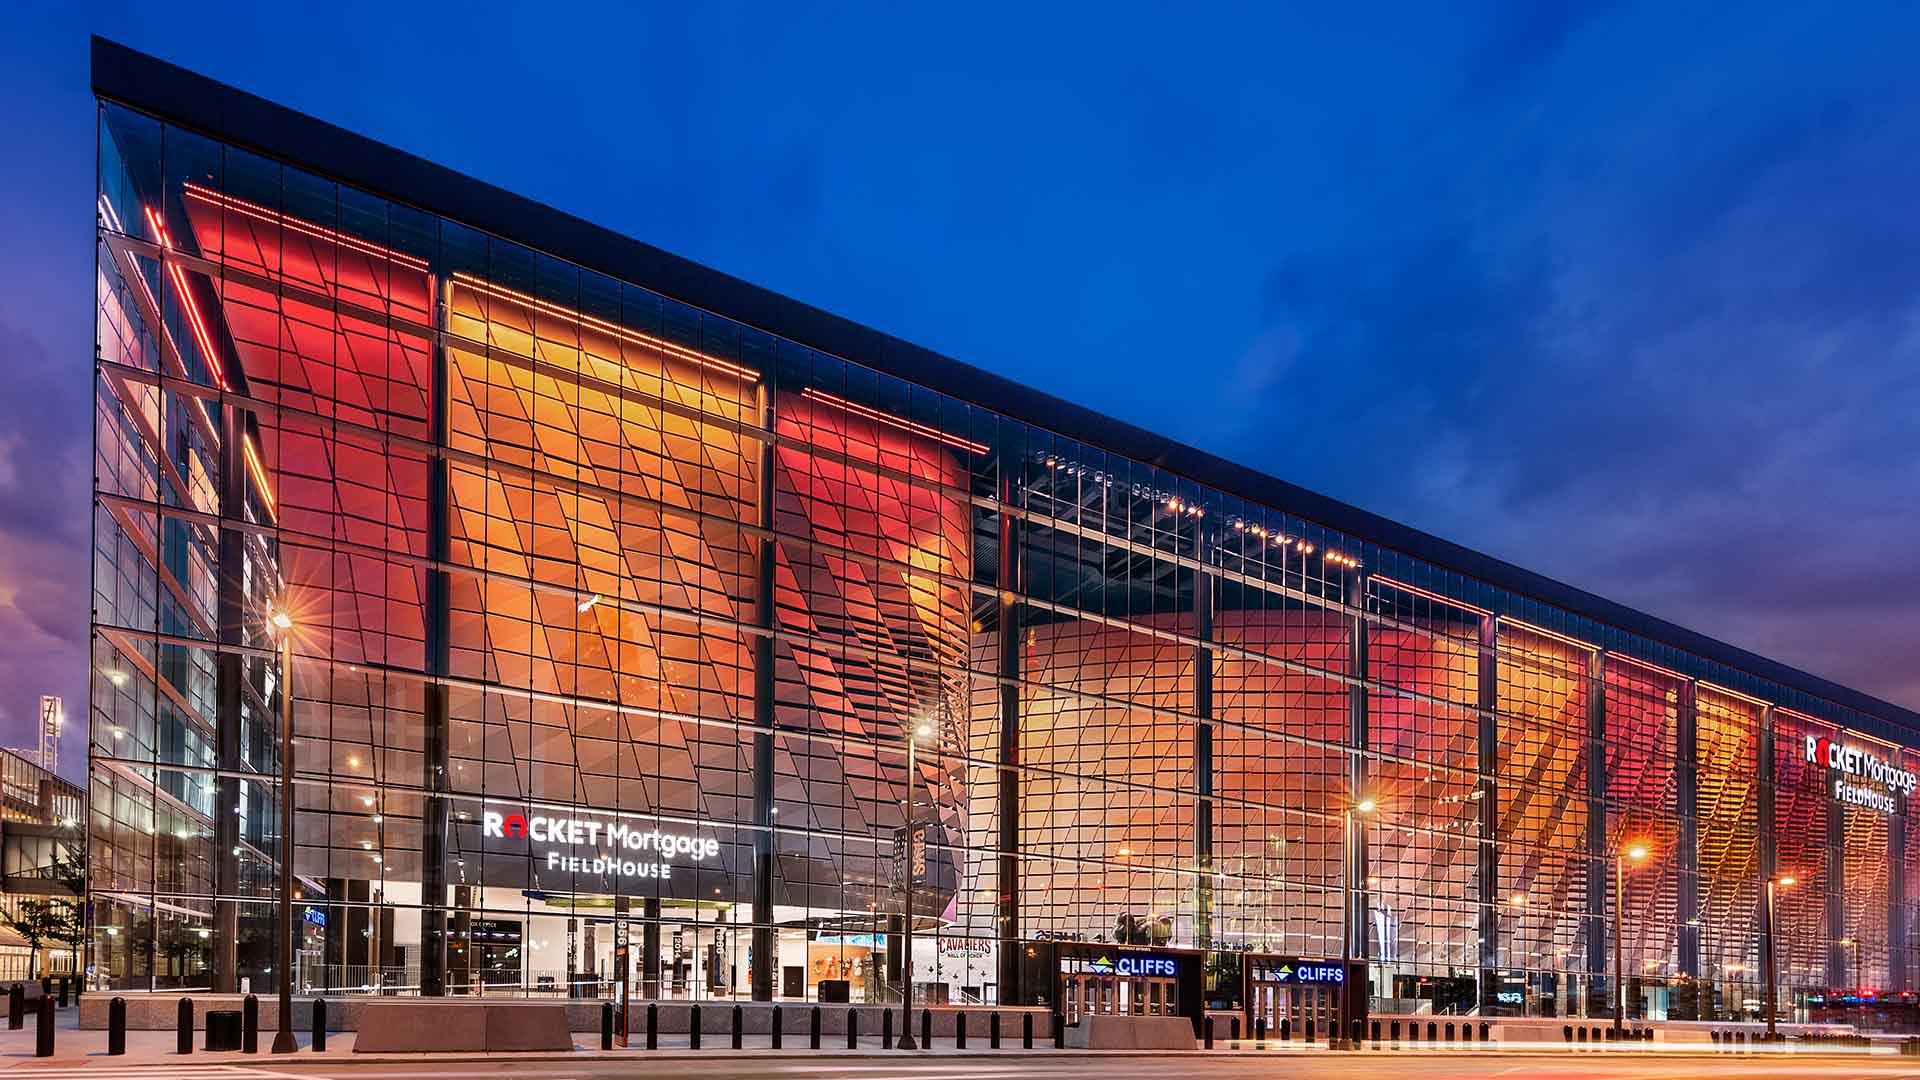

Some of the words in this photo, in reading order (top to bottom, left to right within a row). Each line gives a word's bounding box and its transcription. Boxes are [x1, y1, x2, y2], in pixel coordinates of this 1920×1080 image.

[1806, 735, 1862, 775] ROCKET
[1864, 752, 1917, 796] Mortgage
[1835, 780, 1895, 813] FIELDHOUSE
[482, 811, 602, 846] ROCKET
[607, 822, 719, 861] Mortgage
[547, 851, 672, 879] FIELDHOUSE
[1118, 958, 1175, 975] CLIFFS
[1297, 966, 1344, 981] CLIFFS
